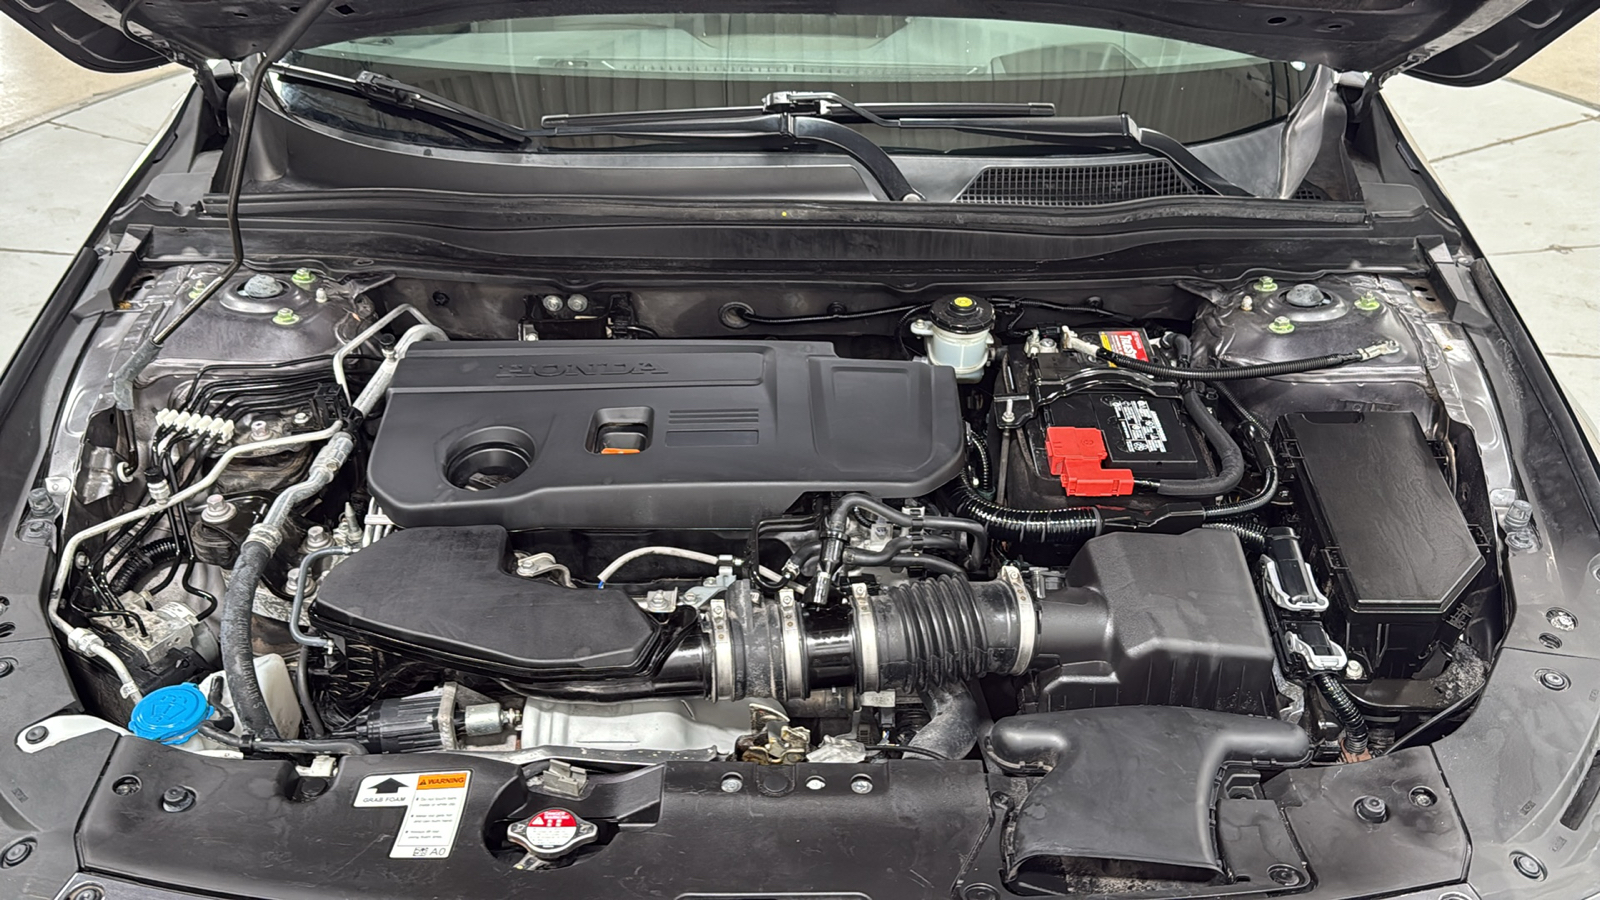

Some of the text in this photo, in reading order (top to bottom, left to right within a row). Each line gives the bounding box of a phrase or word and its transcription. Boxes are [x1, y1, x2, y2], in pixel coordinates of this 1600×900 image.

[496, 361, 669, 379] HONDA
[428, 777, 465, 785] WARNING
[429, 847, 446, 856] A0
